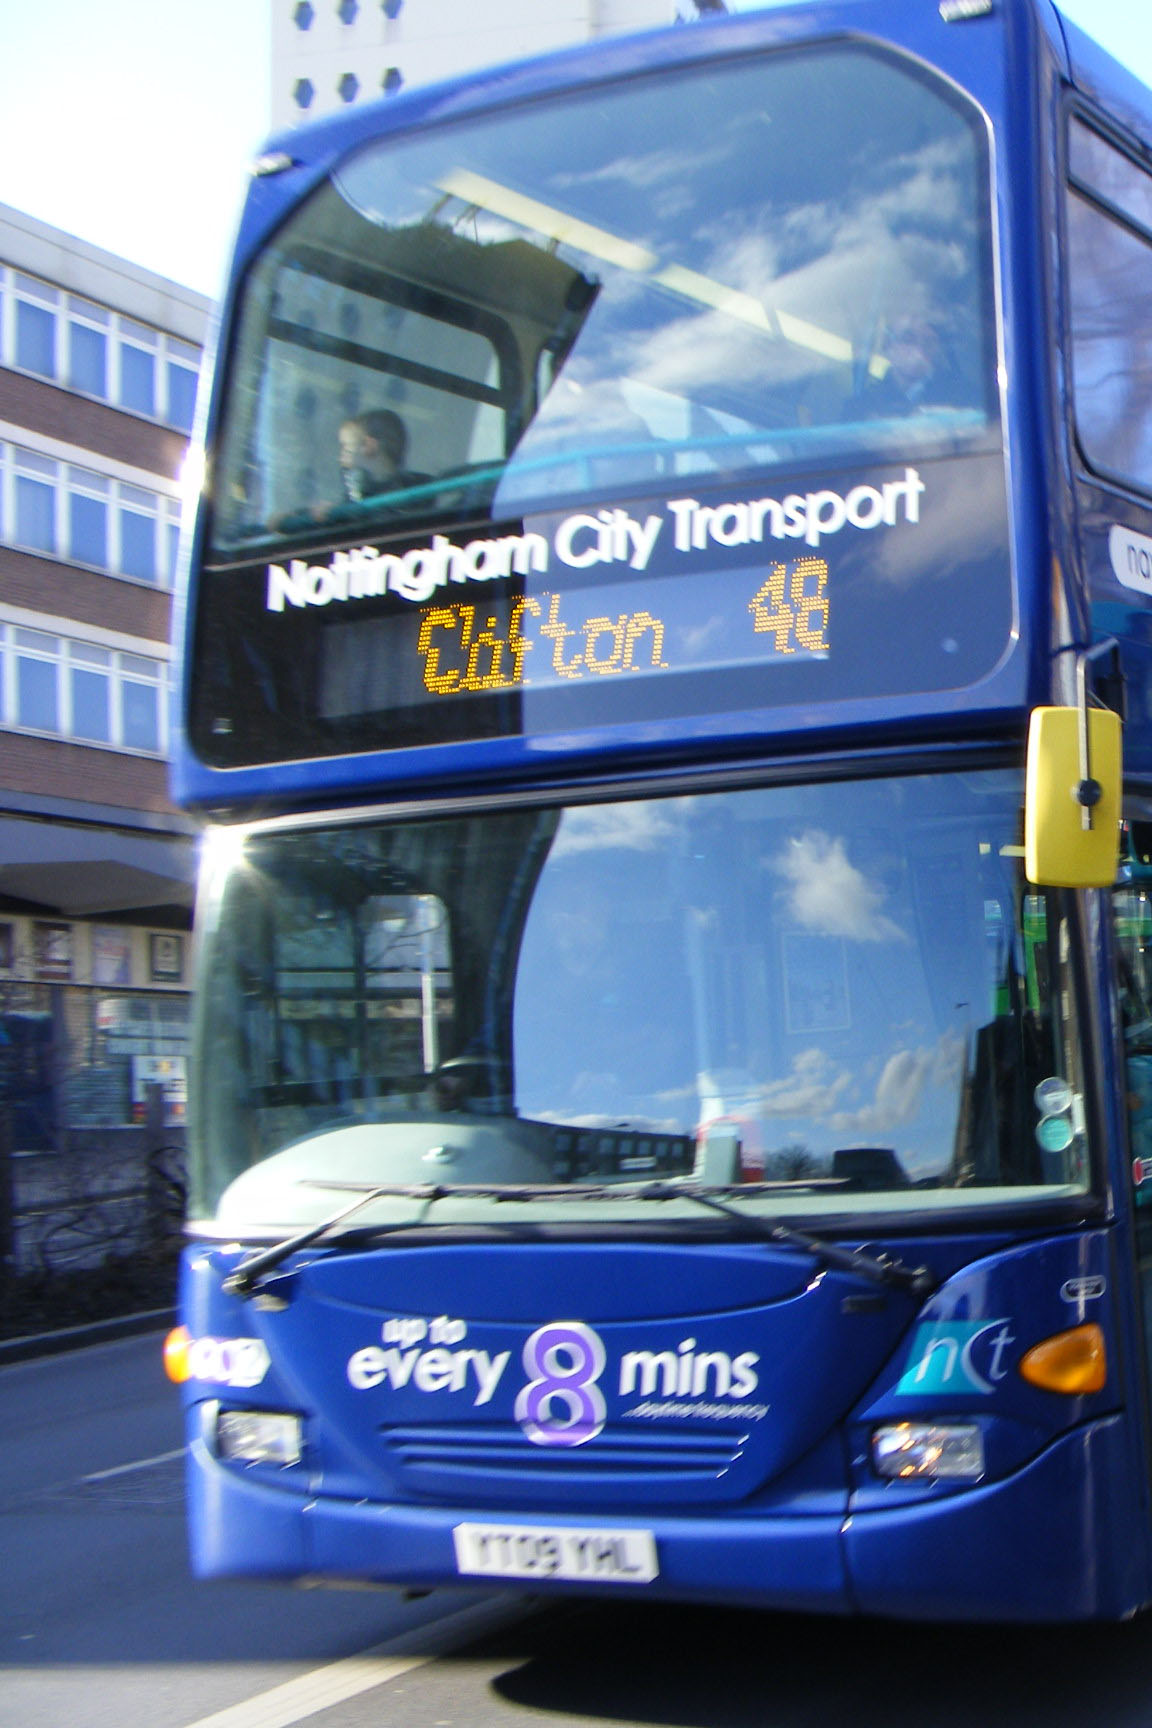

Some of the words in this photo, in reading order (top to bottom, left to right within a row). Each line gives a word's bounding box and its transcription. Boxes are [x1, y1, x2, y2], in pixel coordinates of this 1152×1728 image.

[267, 535, 547, 611] Nottingham
[556, 510, 662, 570] City
[668, 468, 925, 553] Transport
[747, 557, 831, 655] 48
[346, 1345, 512, 1406] every
[513, 1319, 608, 1448] 8
[618, 1337, 760, 1399] mins
[381, 1318, 429, 1350] up
[429, 1315, 468, 1345] to
